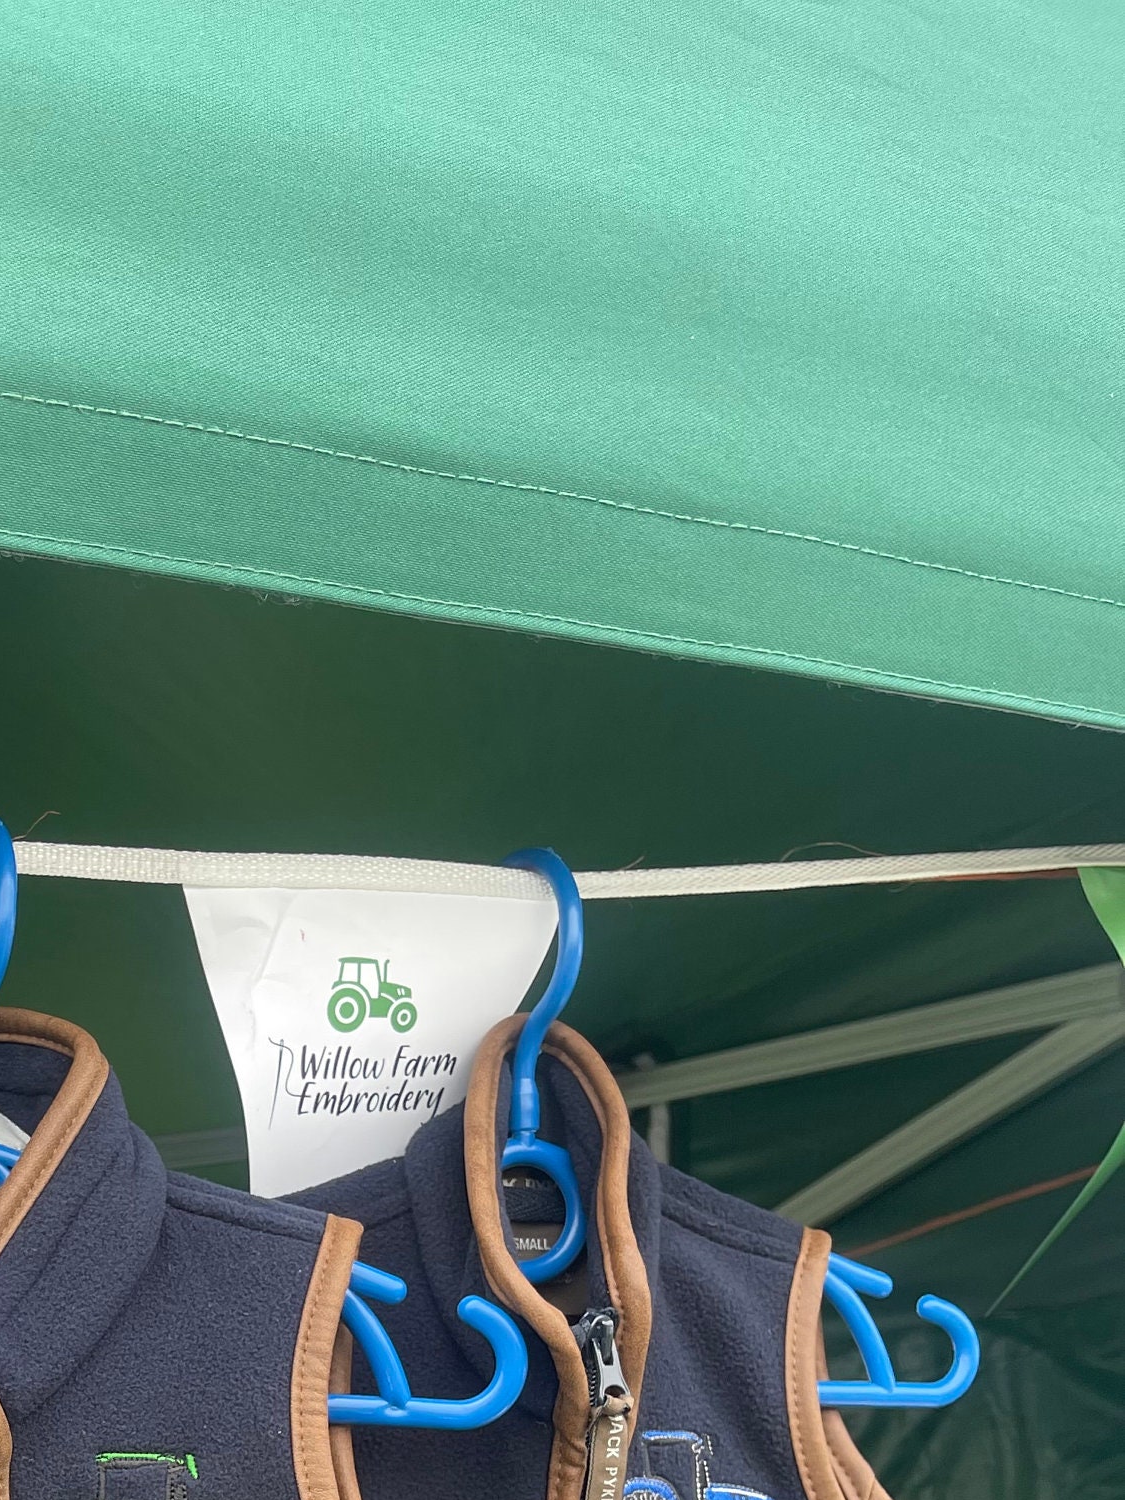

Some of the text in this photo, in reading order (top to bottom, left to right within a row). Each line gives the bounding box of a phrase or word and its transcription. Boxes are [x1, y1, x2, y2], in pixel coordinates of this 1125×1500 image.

[300, 1045, 457, 1080] Willow Farm
[297, 1079, 445, 1121] Embroidery
